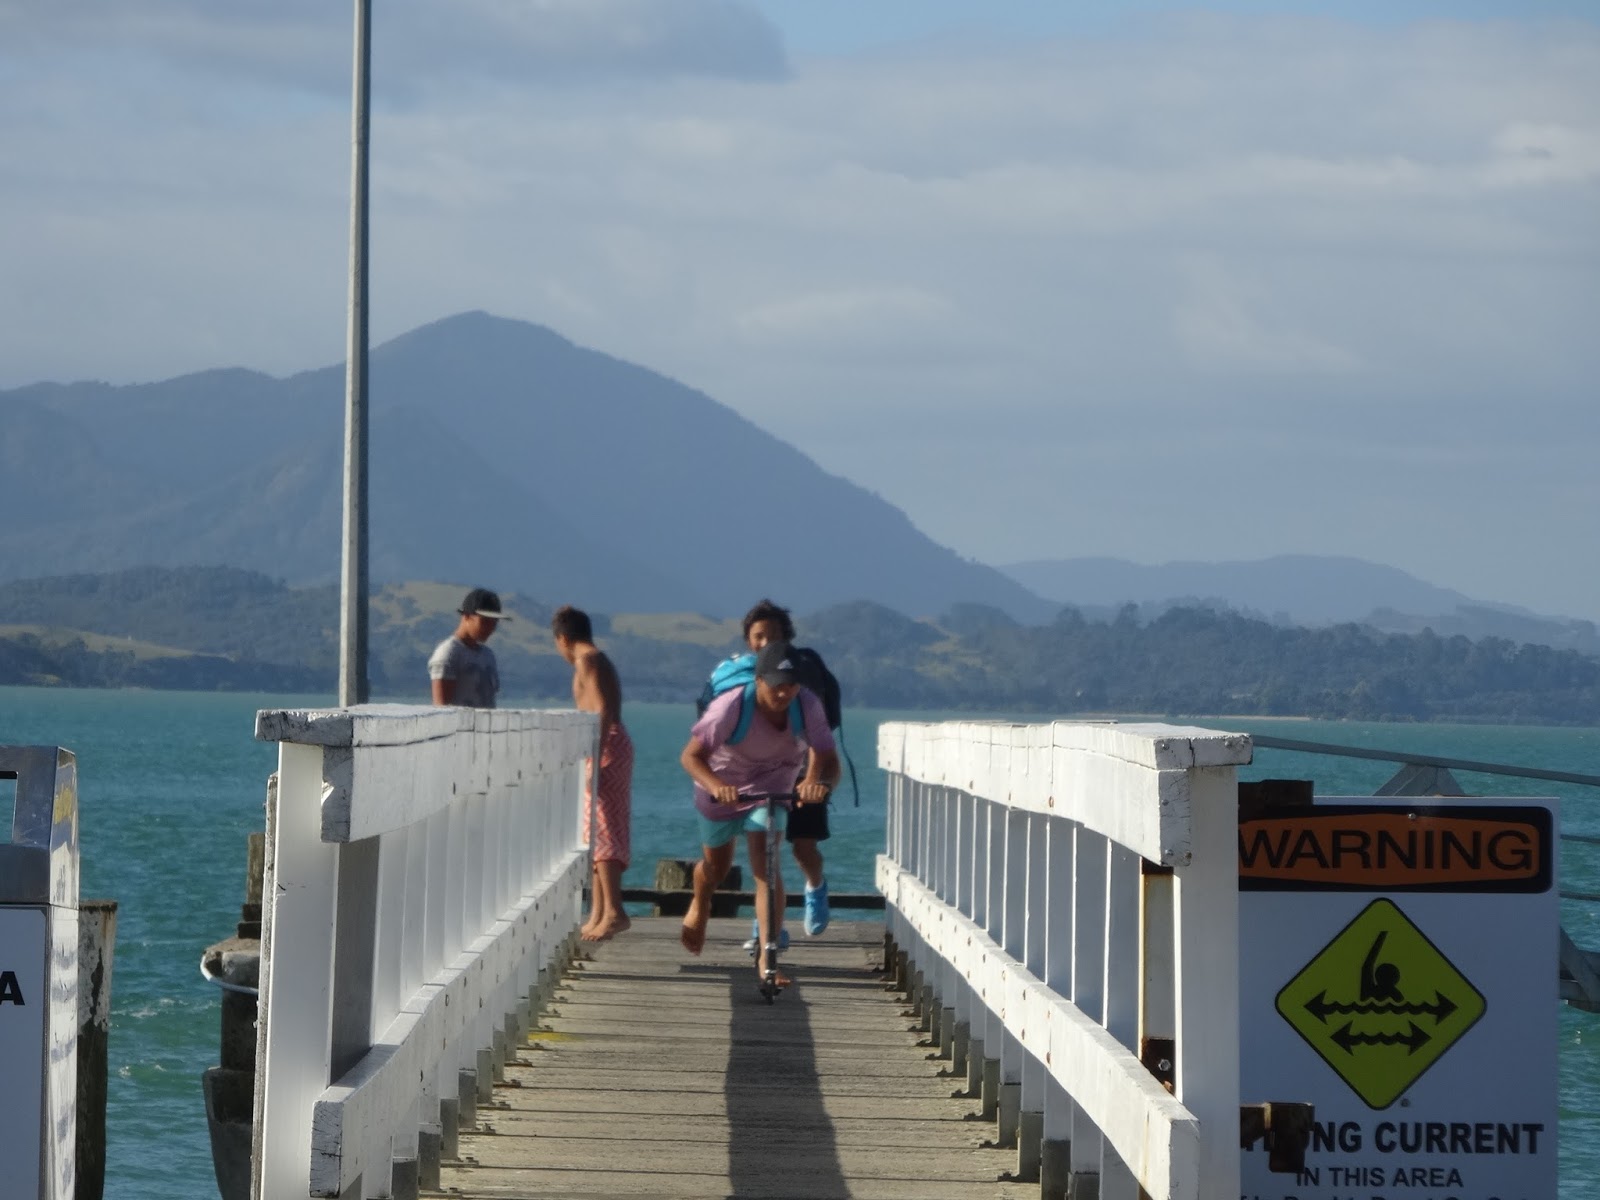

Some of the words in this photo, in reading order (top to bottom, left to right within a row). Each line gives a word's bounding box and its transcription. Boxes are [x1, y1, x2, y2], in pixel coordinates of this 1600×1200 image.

[1238, 829, 1533, 871] WARNING
[1374, 1121, 1545, 1155] CURRENT
[1295, 1167, 1320, 1187] IN
[1328, 1167, 1386, 1188] THIS
[1391, 1167, 1464, 1188] AREA
